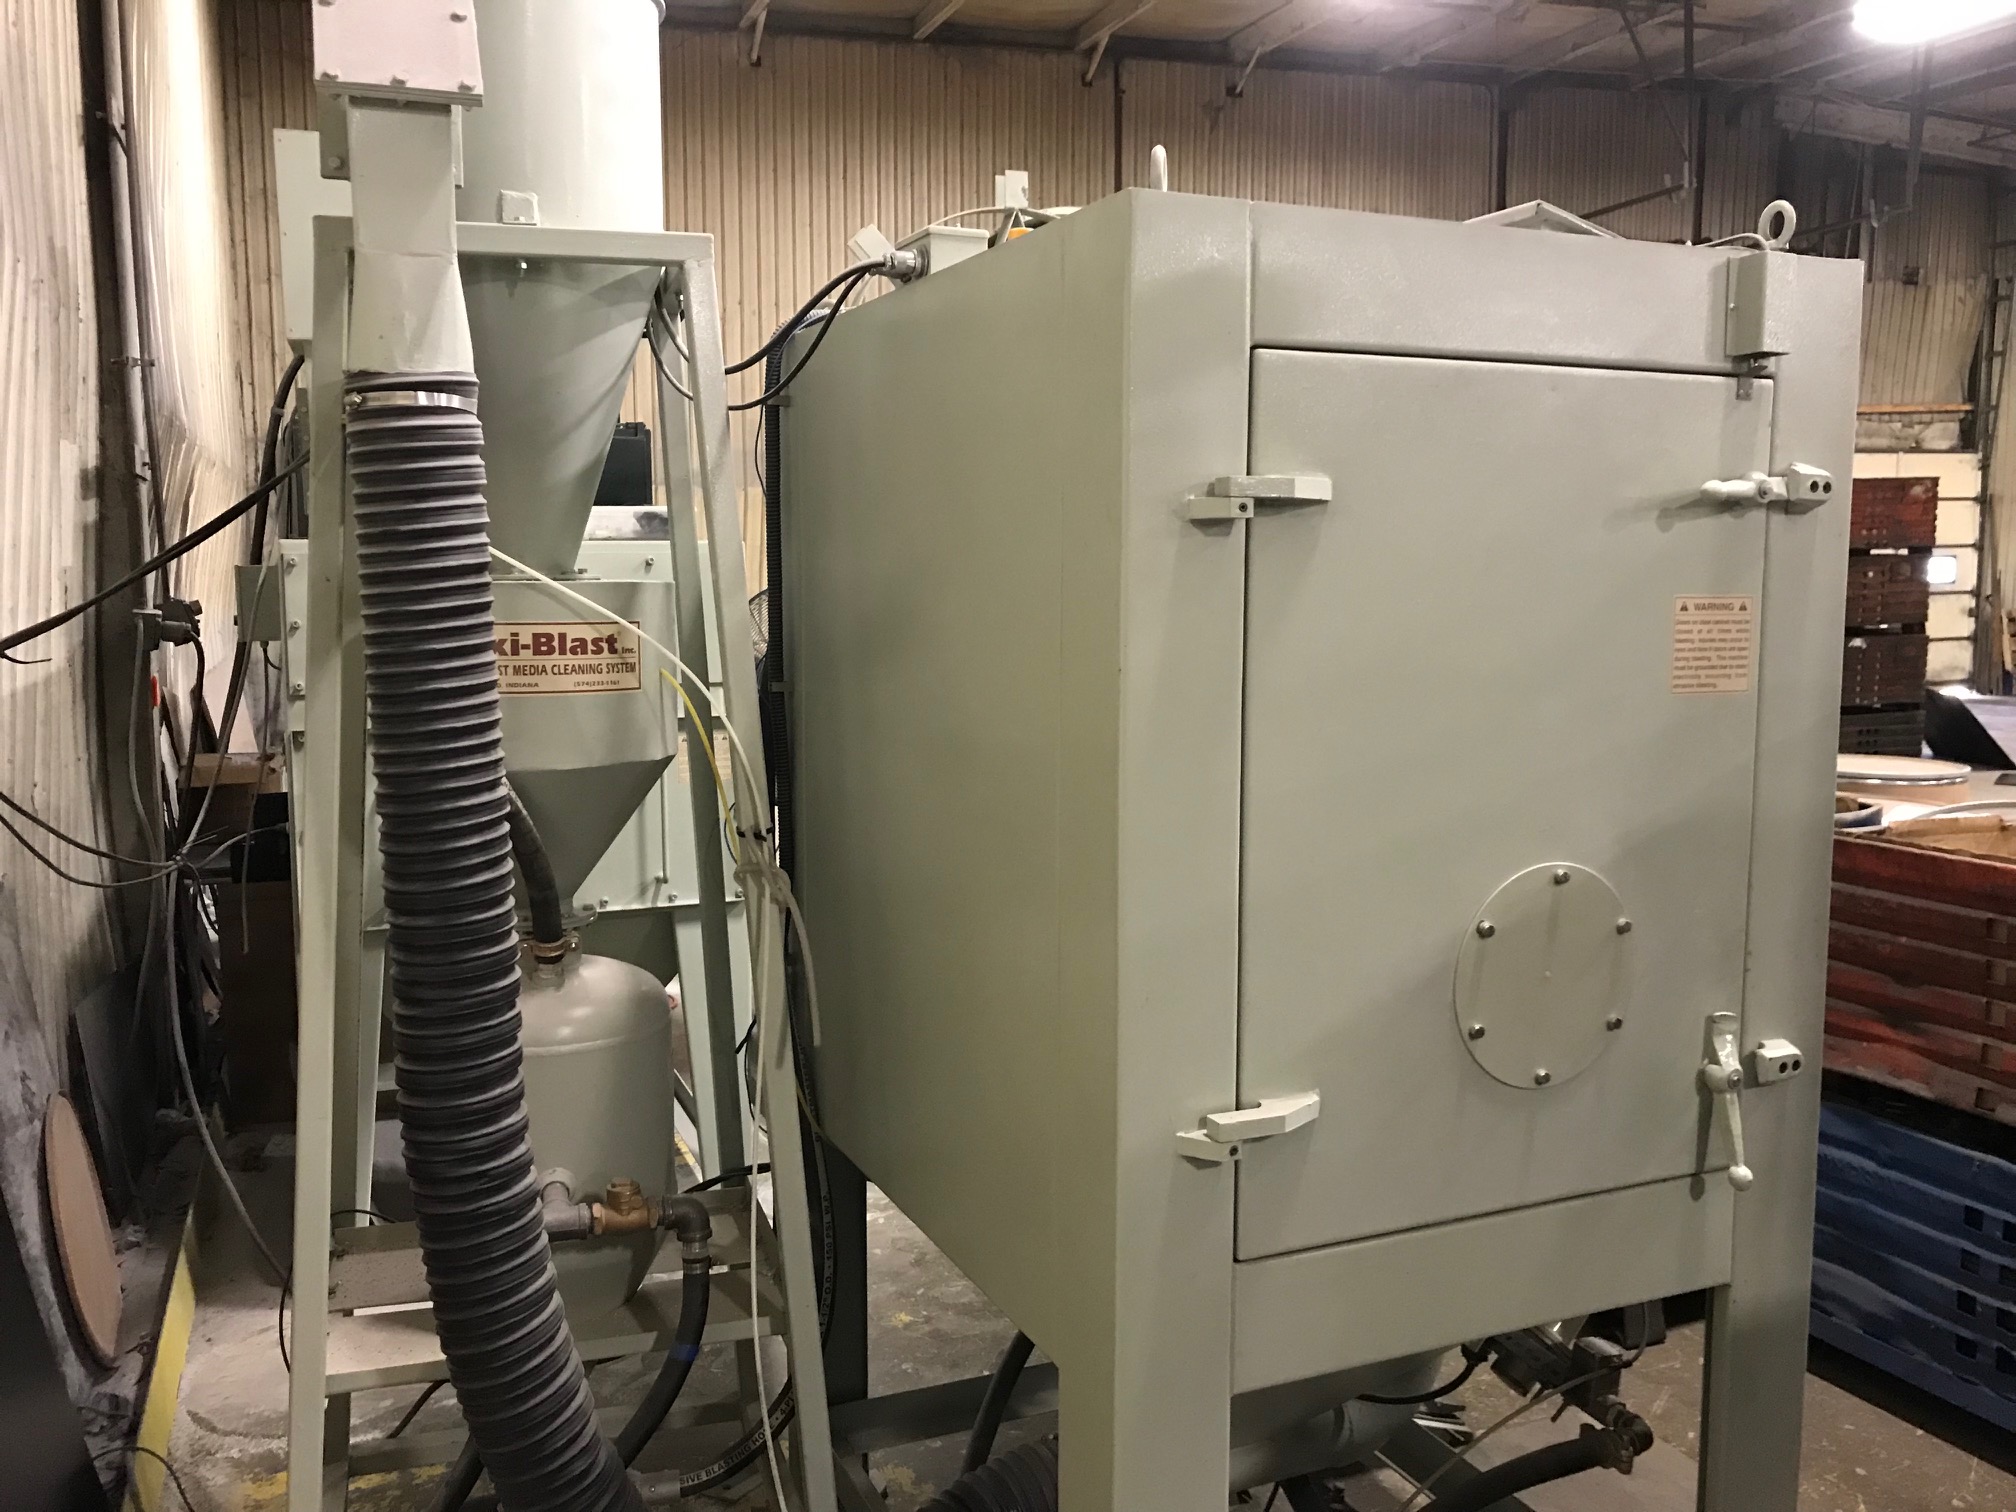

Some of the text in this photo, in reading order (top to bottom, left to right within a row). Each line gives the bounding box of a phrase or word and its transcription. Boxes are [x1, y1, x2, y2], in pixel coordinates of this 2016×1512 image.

[1694, 602, 1735, 611] WARNING
[512, 664, 549, 676] MEDIA
[551, 663, 603, 676] CLEANING
[606, 661, 637, 674] SYSTEM
[705, 1442, 752, 1477] BLASTING
[751, 1419, 776, 1446] HOE
